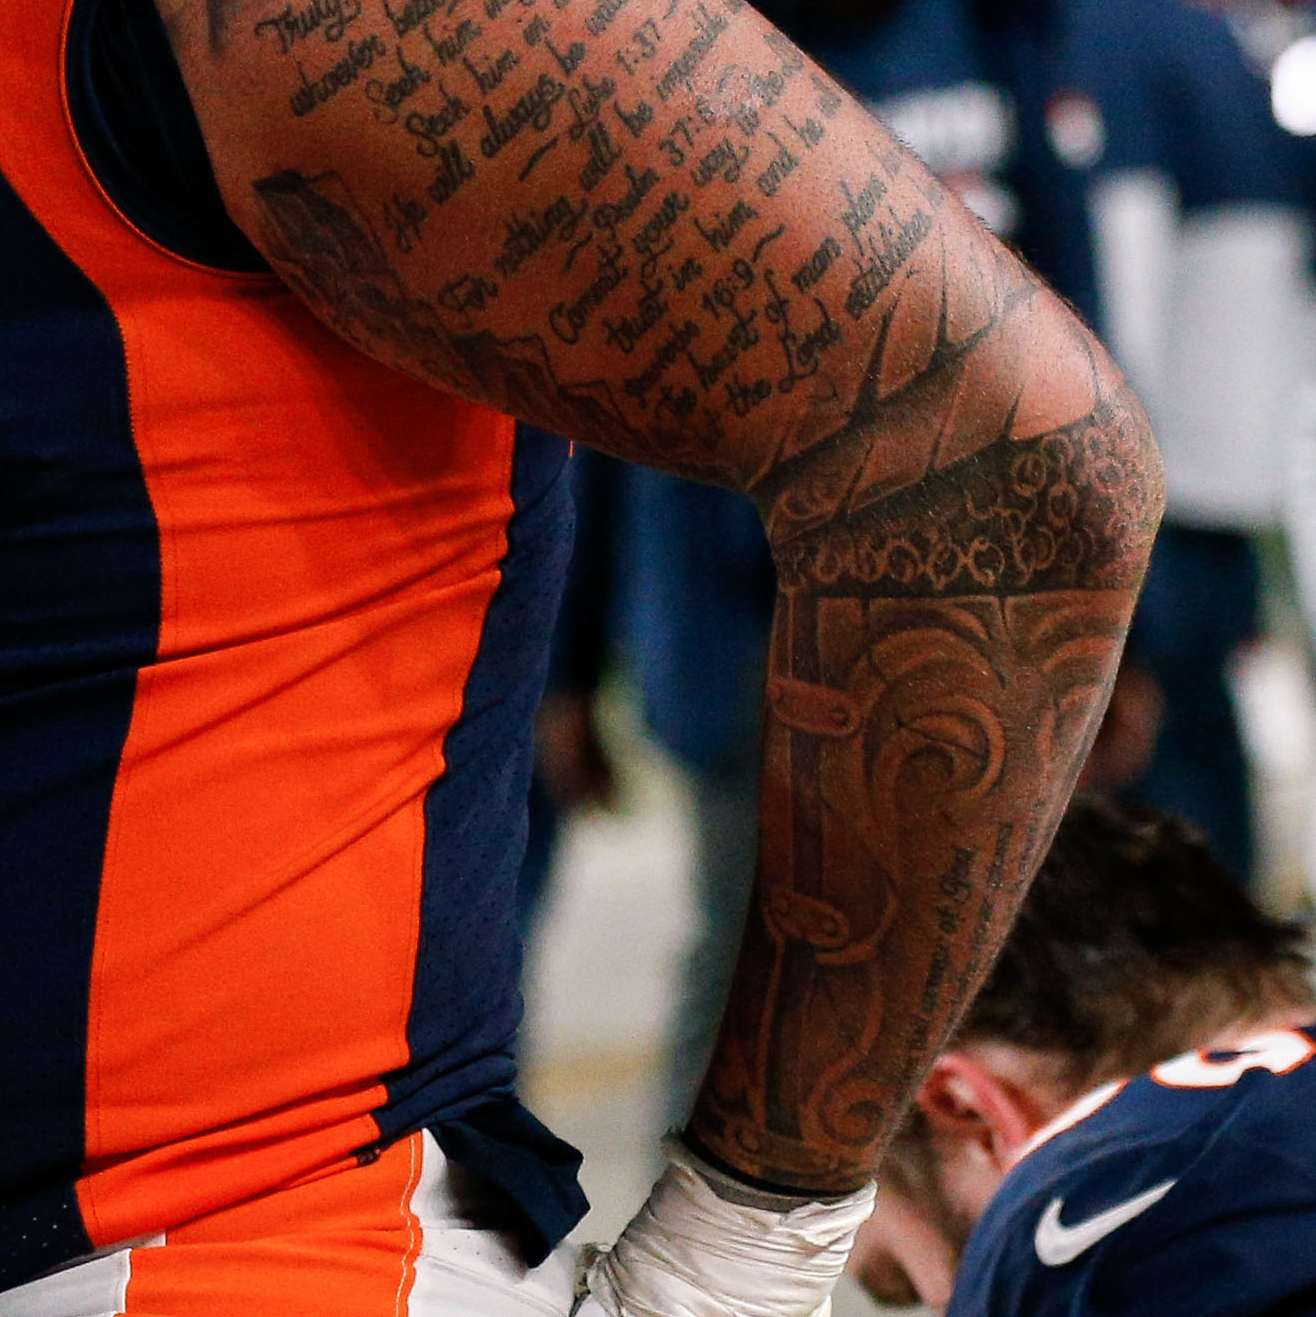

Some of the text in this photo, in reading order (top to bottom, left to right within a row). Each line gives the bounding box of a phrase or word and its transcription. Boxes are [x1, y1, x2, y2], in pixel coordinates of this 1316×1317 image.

[424, 21, 484, 67] him
[463, 47, 520, 98] him
[616, 16, 666, 76] 1:37
[427, 139, 476, 205] will
[480, 69, 567, 160] always
[544, 36, 587, 78] be
[493, 195, 591, 277] nothing
[578, 120, 624, 194] will
[613, 98, 654, 139] be
[668, 256, 704, 292] in
[693, 200, 763, 253] him
[757, 130, 801, 198] and
[782, 116, 825, 152] he
[631, 190, 691, 282] your
[791, 236, 844, 295] man
[723, 374, 773, 419] the
[778, 296, 843, 394] Lord
